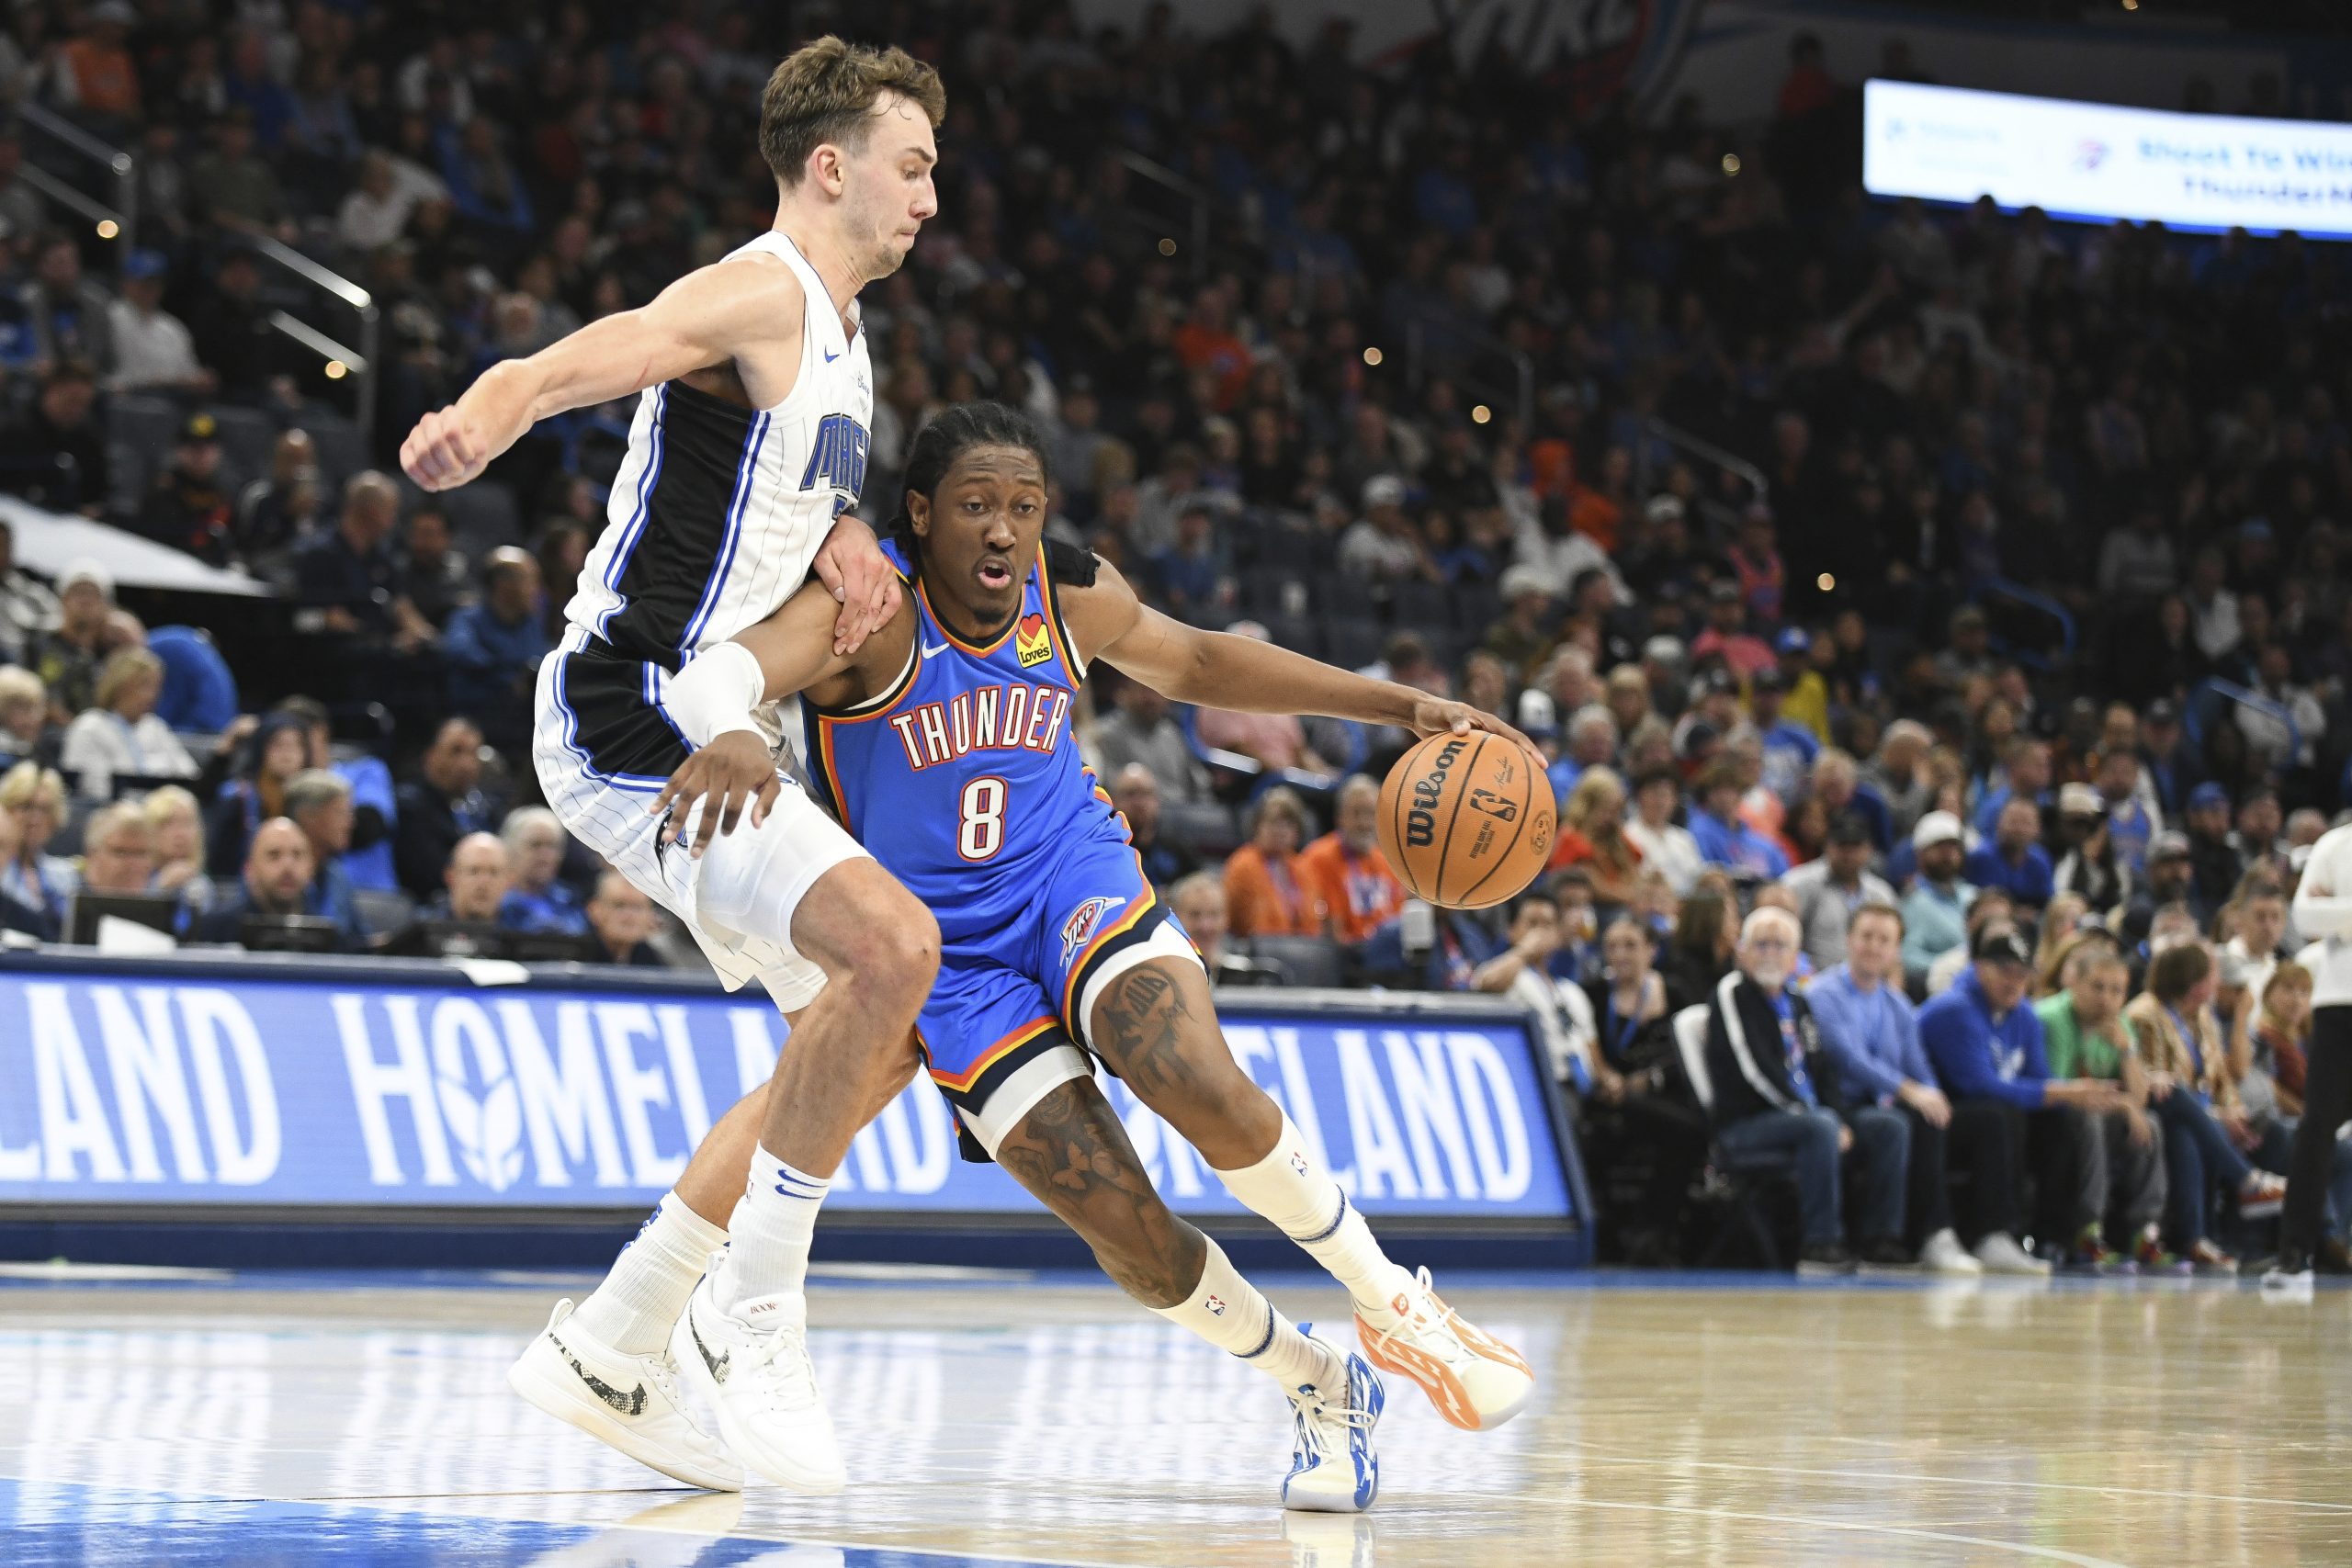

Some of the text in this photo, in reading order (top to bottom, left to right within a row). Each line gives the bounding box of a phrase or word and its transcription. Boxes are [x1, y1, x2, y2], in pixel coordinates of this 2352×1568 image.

[888, 683, 1070, 772] THUNDER
[956, 774, 1009, 863] 8
[1407, 739, 1470, 847] Wilson
[0, 982, 282, 1186] AND
